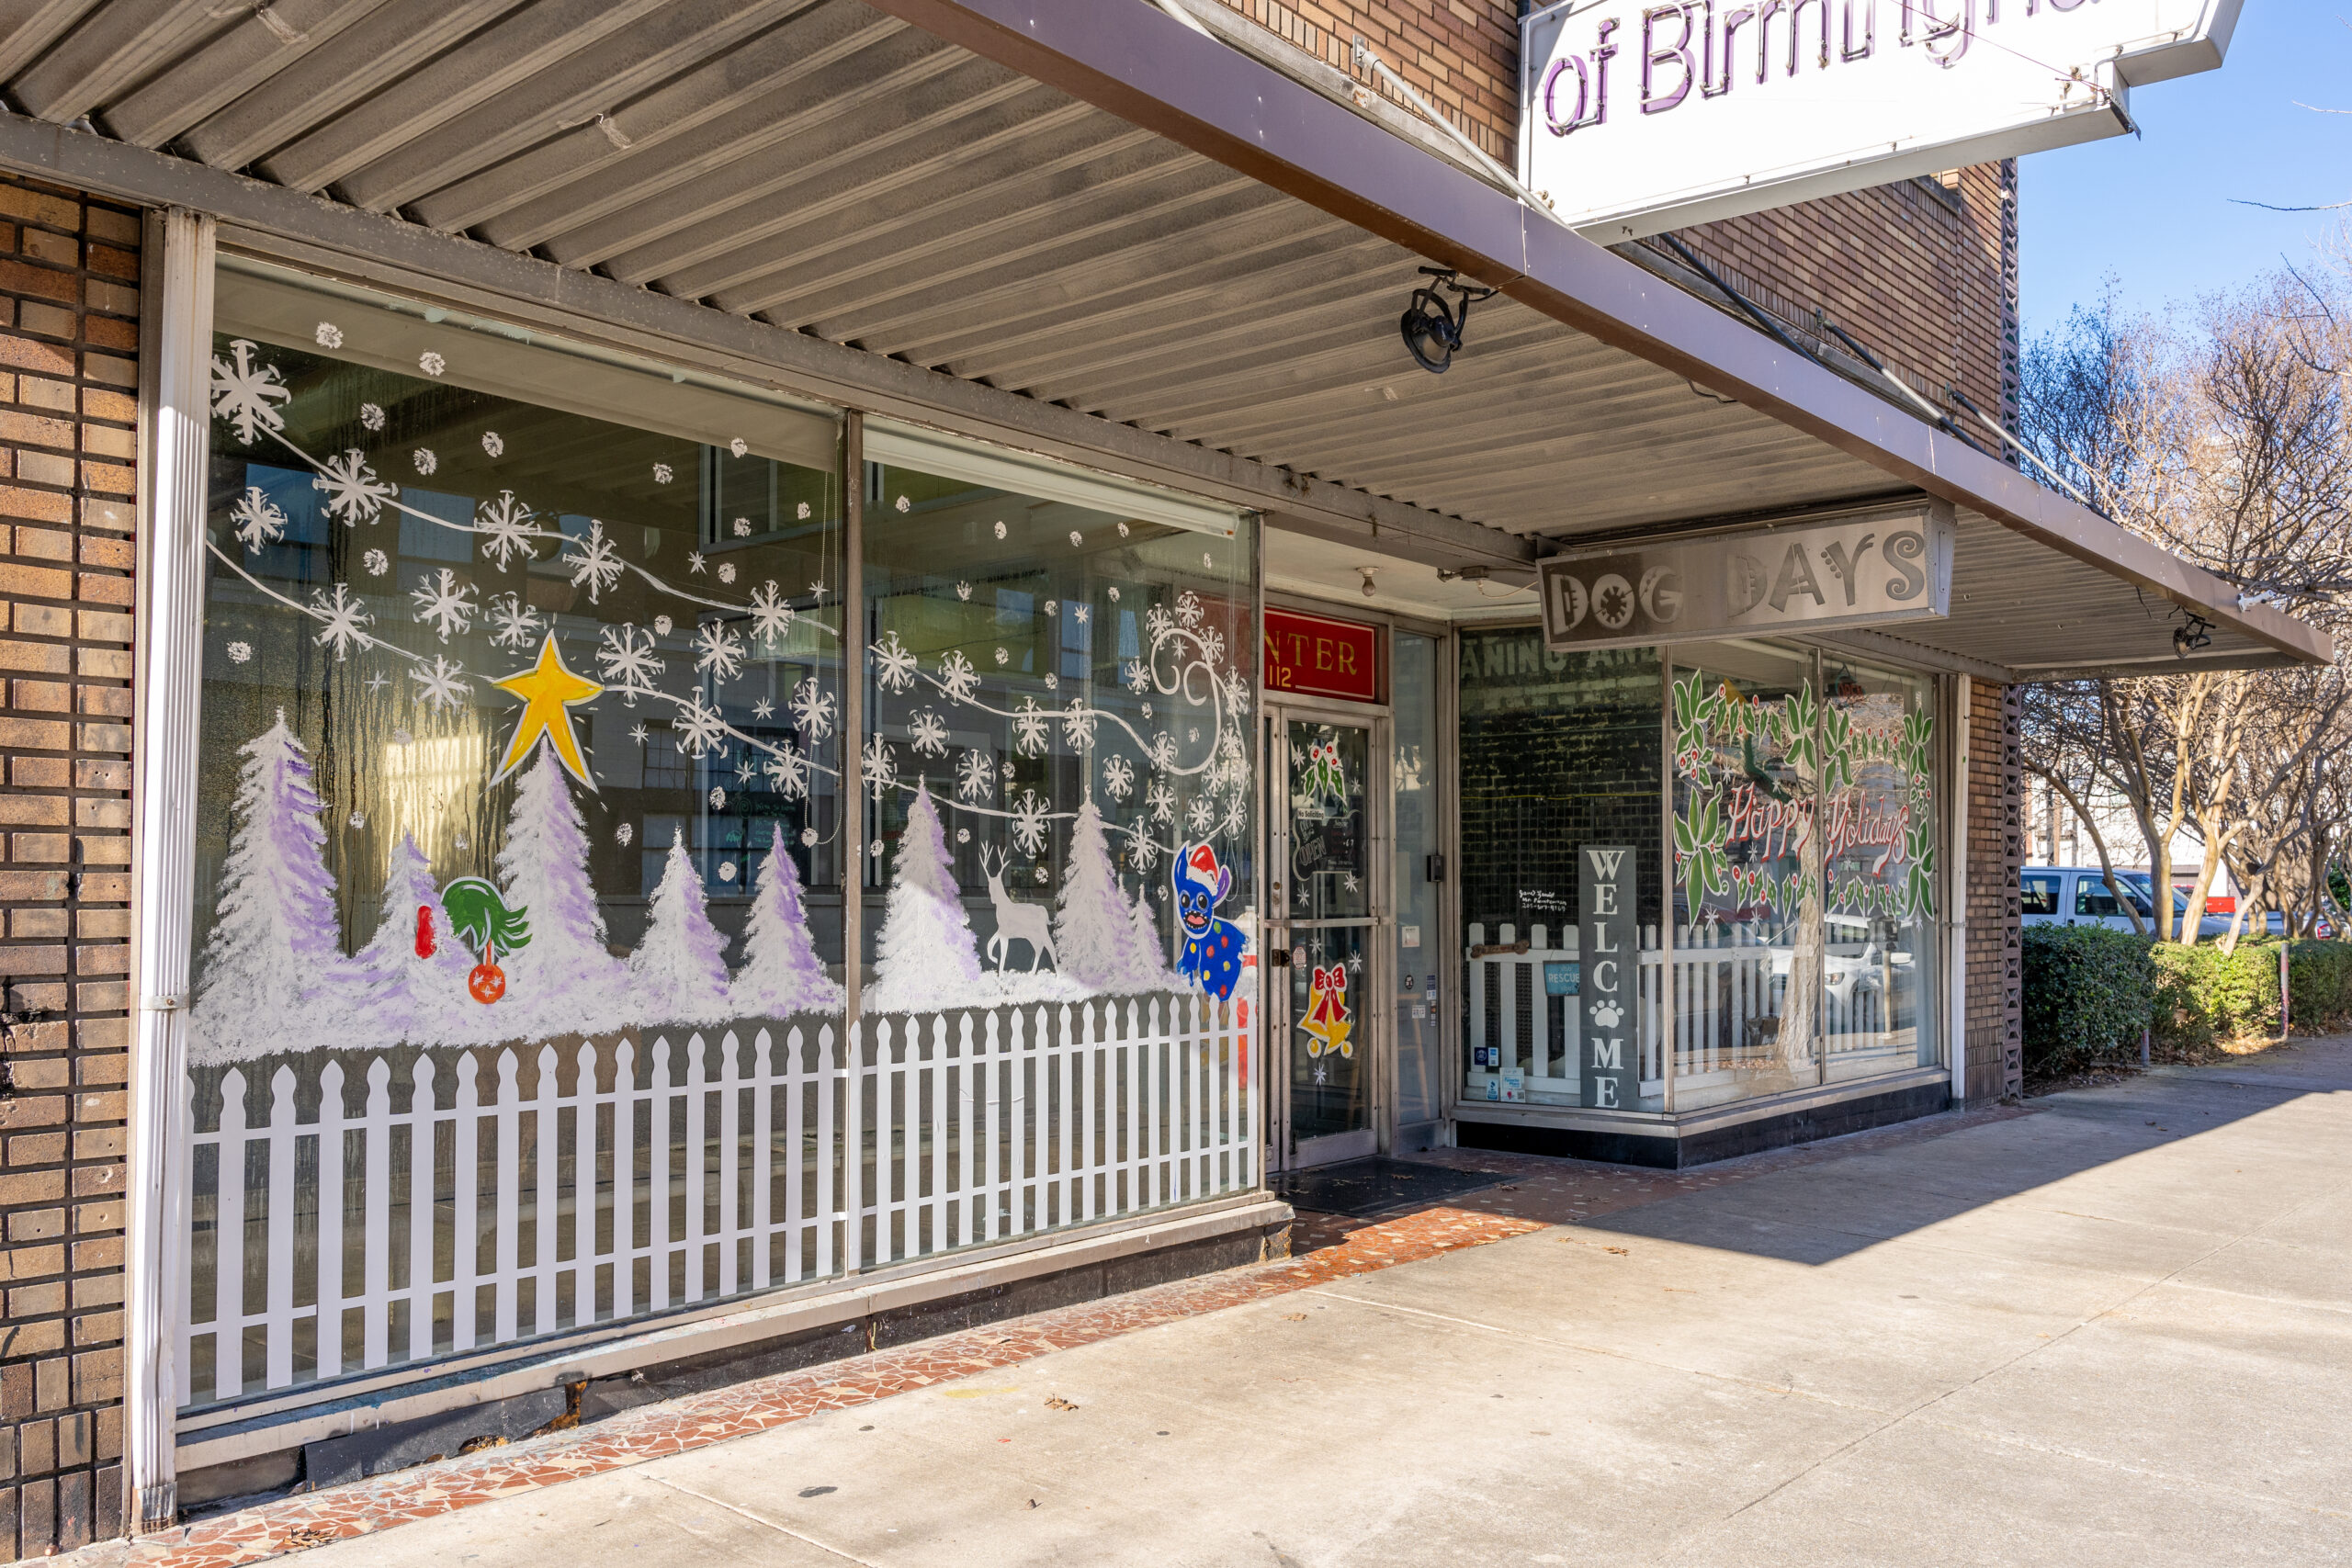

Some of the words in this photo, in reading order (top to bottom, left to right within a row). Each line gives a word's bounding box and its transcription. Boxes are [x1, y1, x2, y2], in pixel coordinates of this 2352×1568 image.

[1543, 17, 1621, 138] of
[1639, 0, 2102, 116] Birming
[1550, 564, 1684, 636] DOG
[1725, 530, 1926, 618] DAYS
[1269, 664, 1292, 688] 112
[1299, 835, 1328, 866] OPEN
[1724, 781, 1816, 863] Happy
[1824, 791, 1910, 879] Holidays
